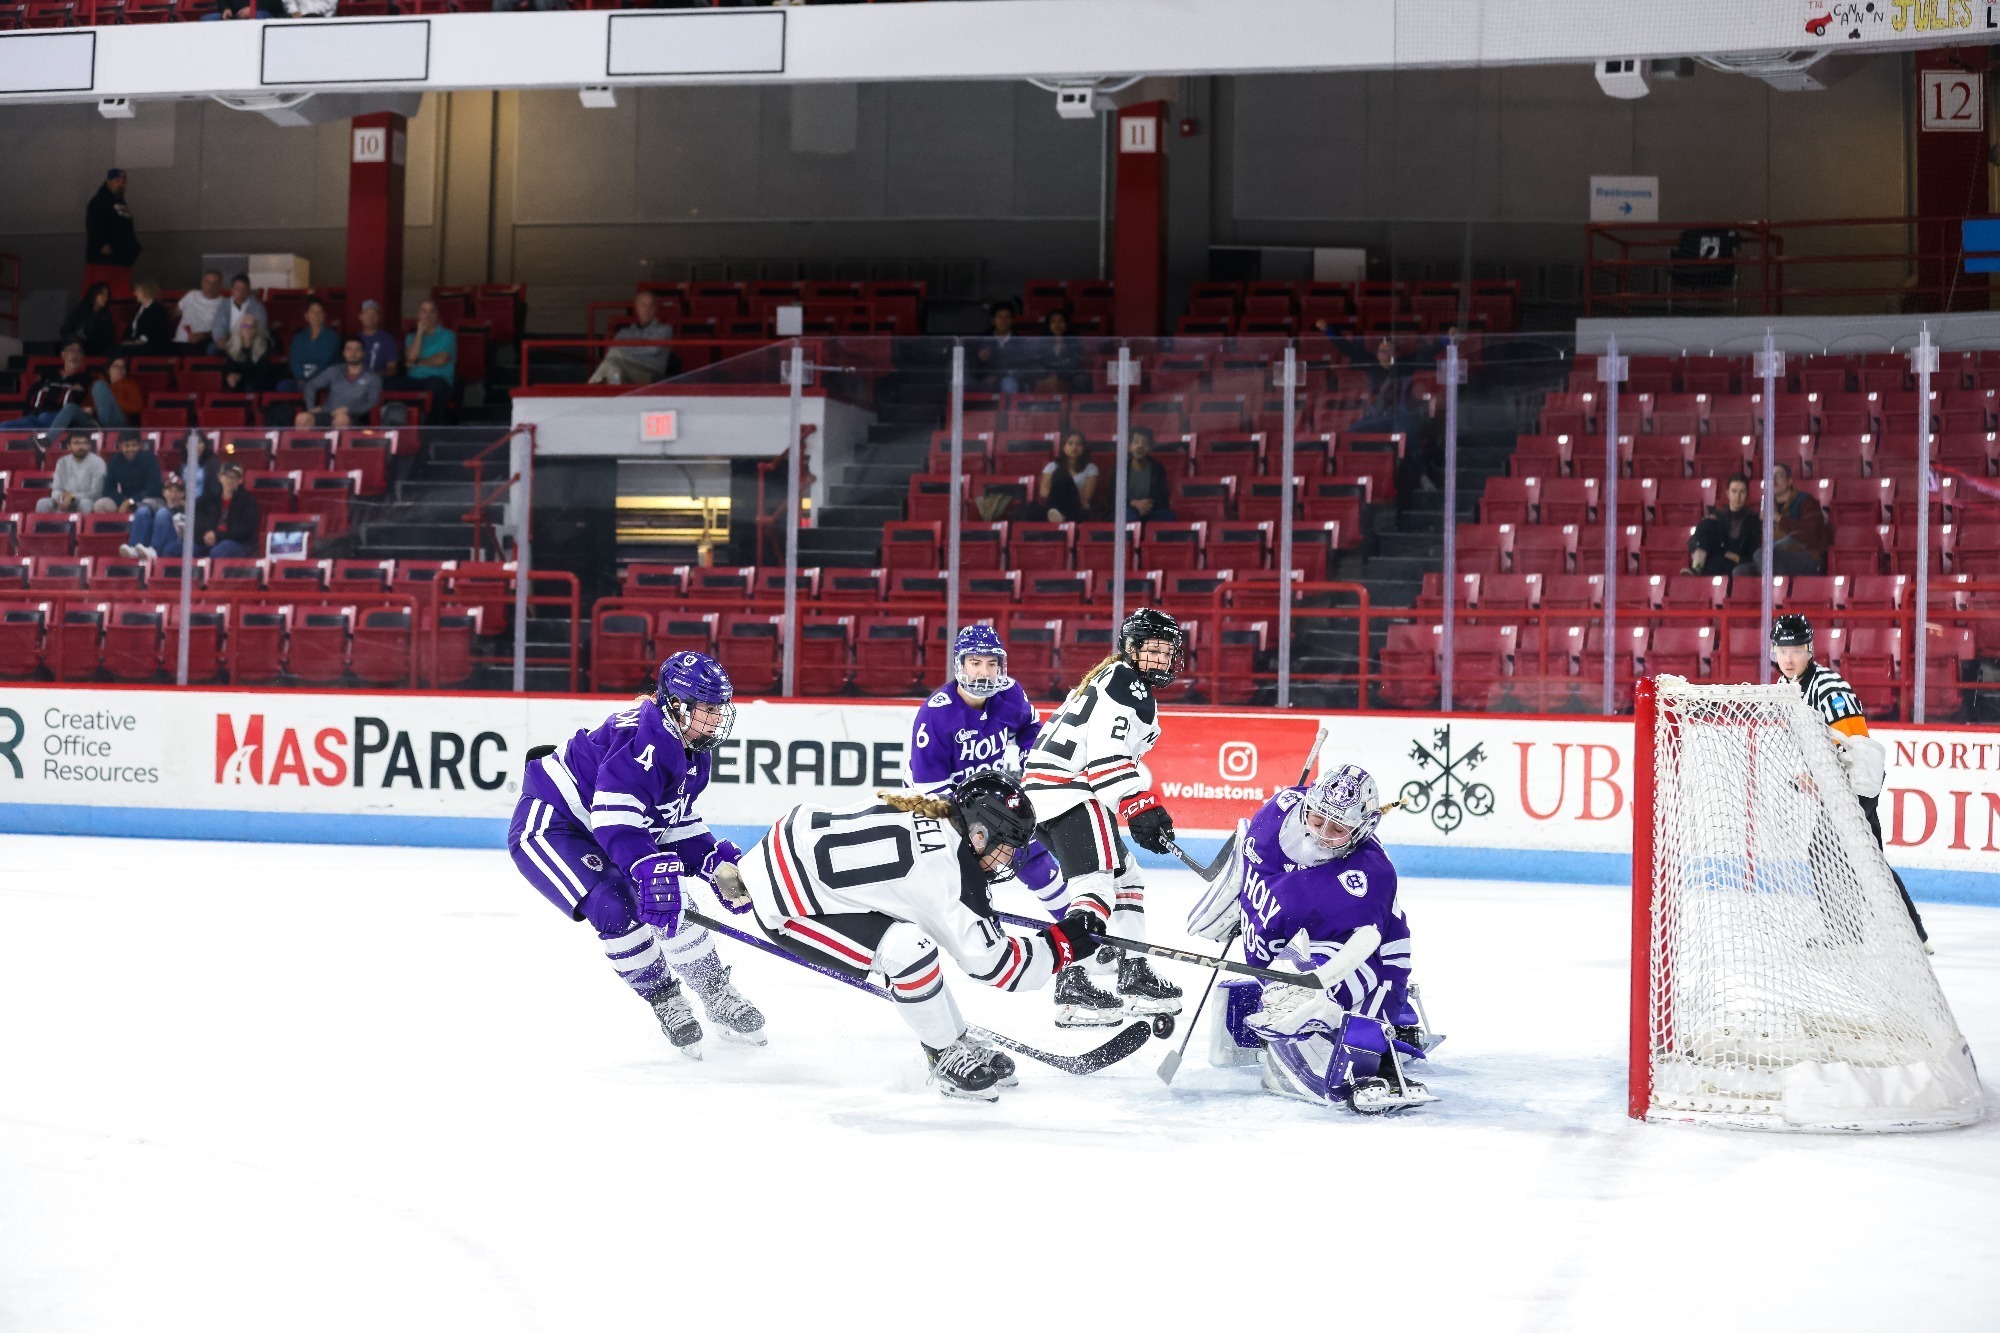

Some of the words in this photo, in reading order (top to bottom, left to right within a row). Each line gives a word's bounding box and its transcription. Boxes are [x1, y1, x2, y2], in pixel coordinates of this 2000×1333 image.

[1891, 0, 1972, 32] JULES
[1932, 81, 1973, 120] 12
[360, 135, 379, 155] 10
[1131, 125, 1145, 145] 11
[646, 415, 672, 436] EXIT
[44, 707, 136, 731] Creative
[44, 734, 112, 757] Office
[916, 723, 930, 749] 6
[960, 726, 1008, 762] HOLY
[633, 743, 656, 772] 4
[1894, 740, 2000, 771] NORT
[44, 759, 160, 783] Resources
[1513, 741, 1634, 821] UB
[1161, 782, 1285, 804] Wollastons
[1243, 863, 1282, 930] HOLY
[1238, 905, 1287, 962] ROSS
